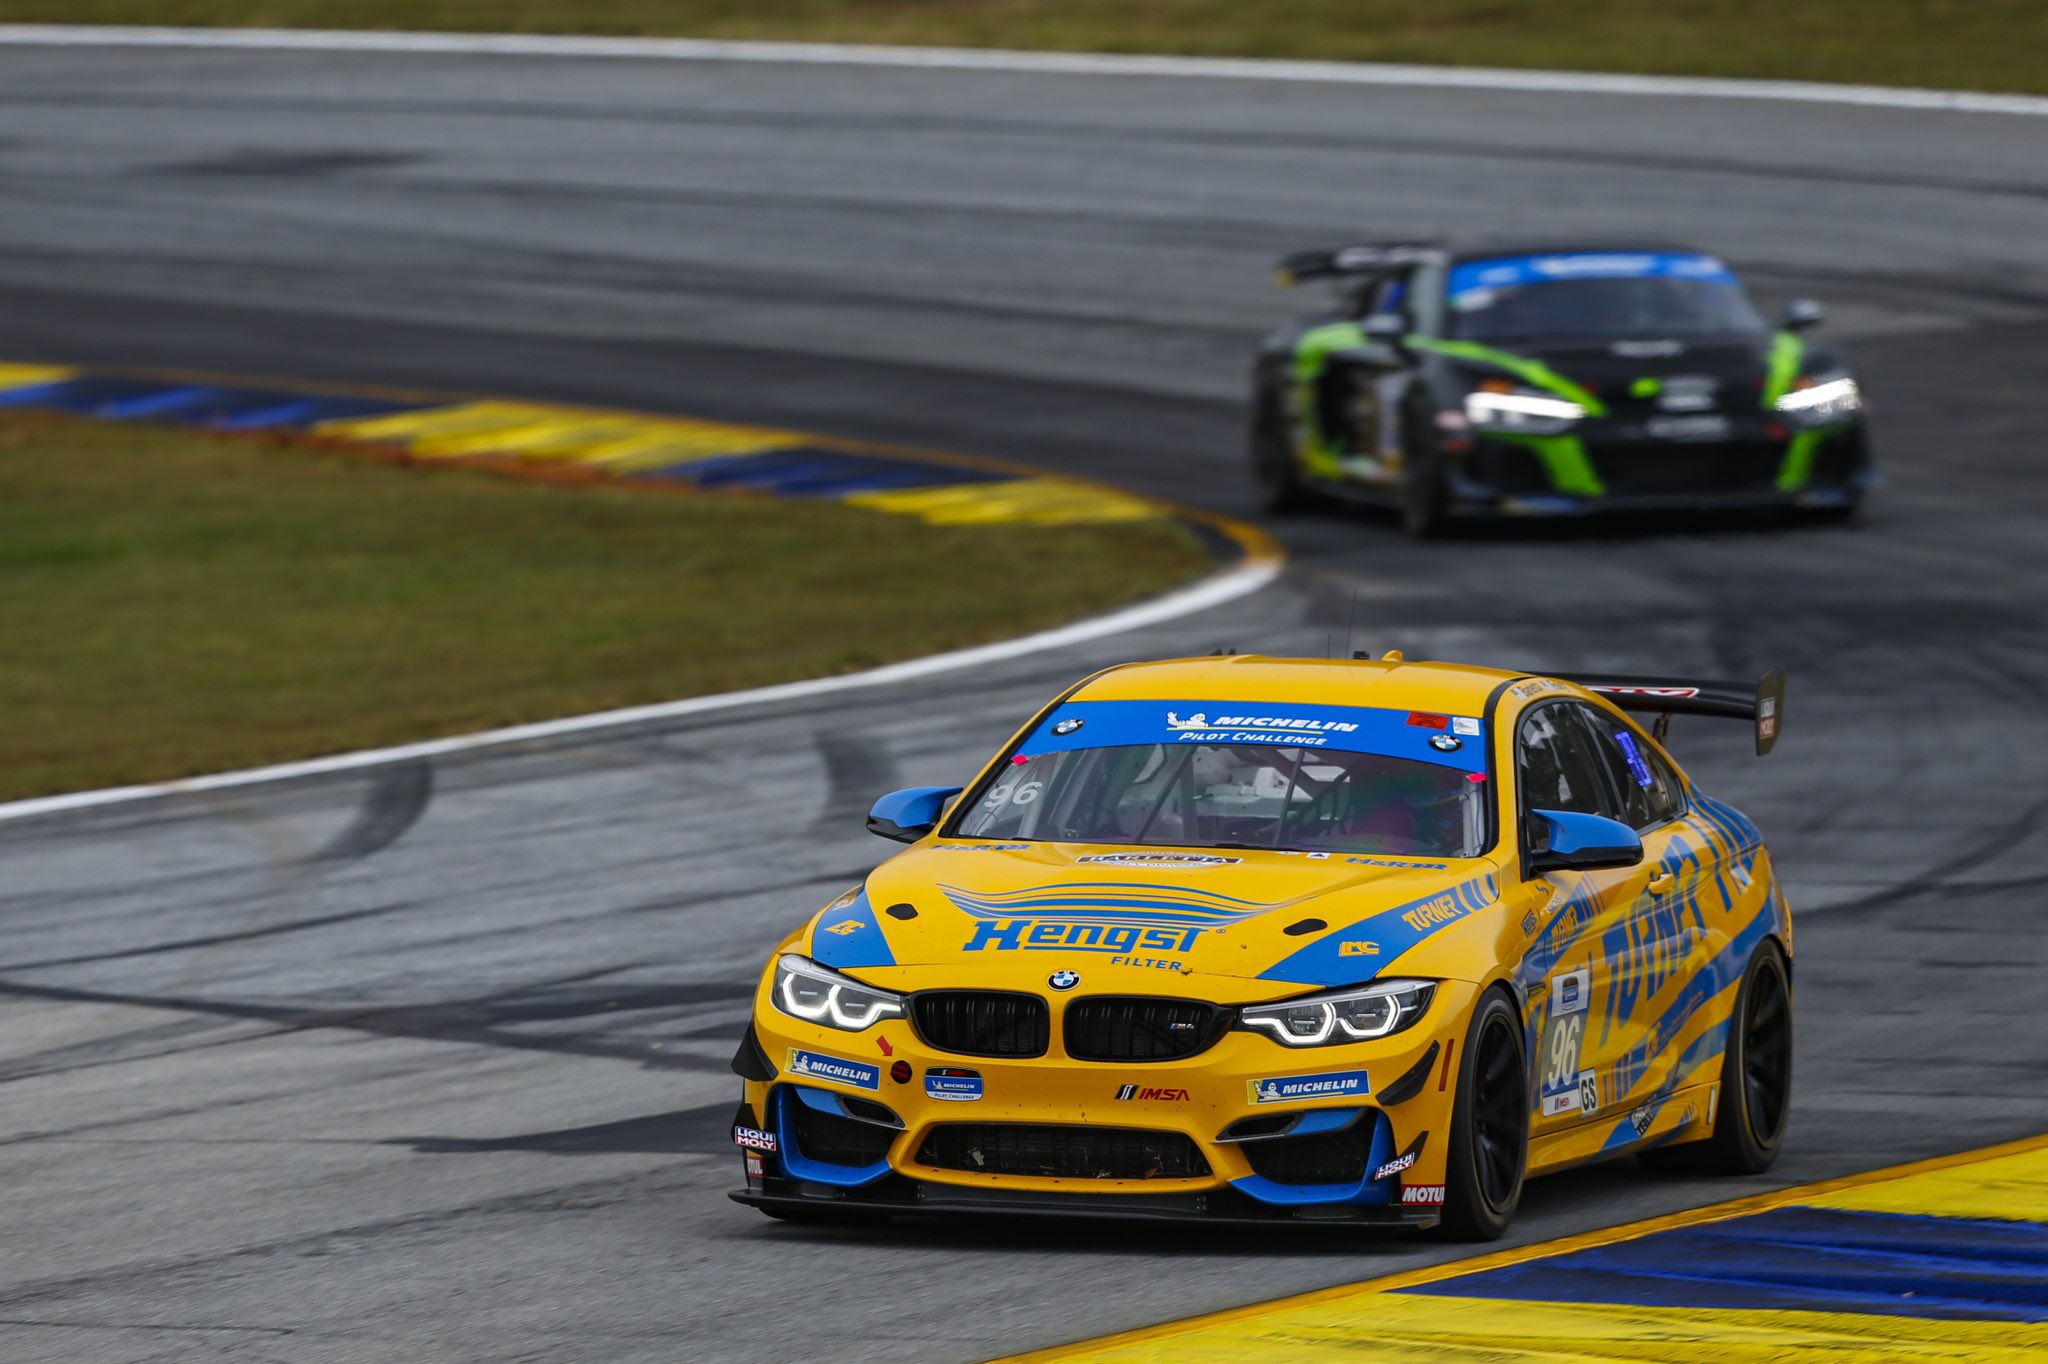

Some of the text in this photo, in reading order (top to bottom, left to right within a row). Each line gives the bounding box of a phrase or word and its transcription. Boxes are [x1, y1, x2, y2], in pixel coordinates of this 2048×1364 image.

[1212, 716, 1359, 733] MICHELIN
[1178, 731, 1329, 746] PILOT CHALLENGE
[984, 781, 1042, 807] 96
[1401, 894, 1463, 932] TURNER
[962, 920, 1209, 954] Hengst
[1339, 941, 1381, 957] LMC
[1110, 956, 1182, 971] FILTER
[1548, 1015, 1580, 1090] 96
[810, 1061, 872, 1082] MICHELIN
[943, 1082, 976, 1090] MICHELIN
[1138, 1087, 1191, 1101] IMSA
[1281, 1078, 1359, 1094] MICHELIN
[1581, 1077, 1597, 1112] GS
[736, 1126, 774, 1142] LIQUI
[736, 1136, 775, 1150] MOLY
[1377, 1160, 1413, 1179] MOLY
[1379, 1154, 1413, 1172] LIQUI
